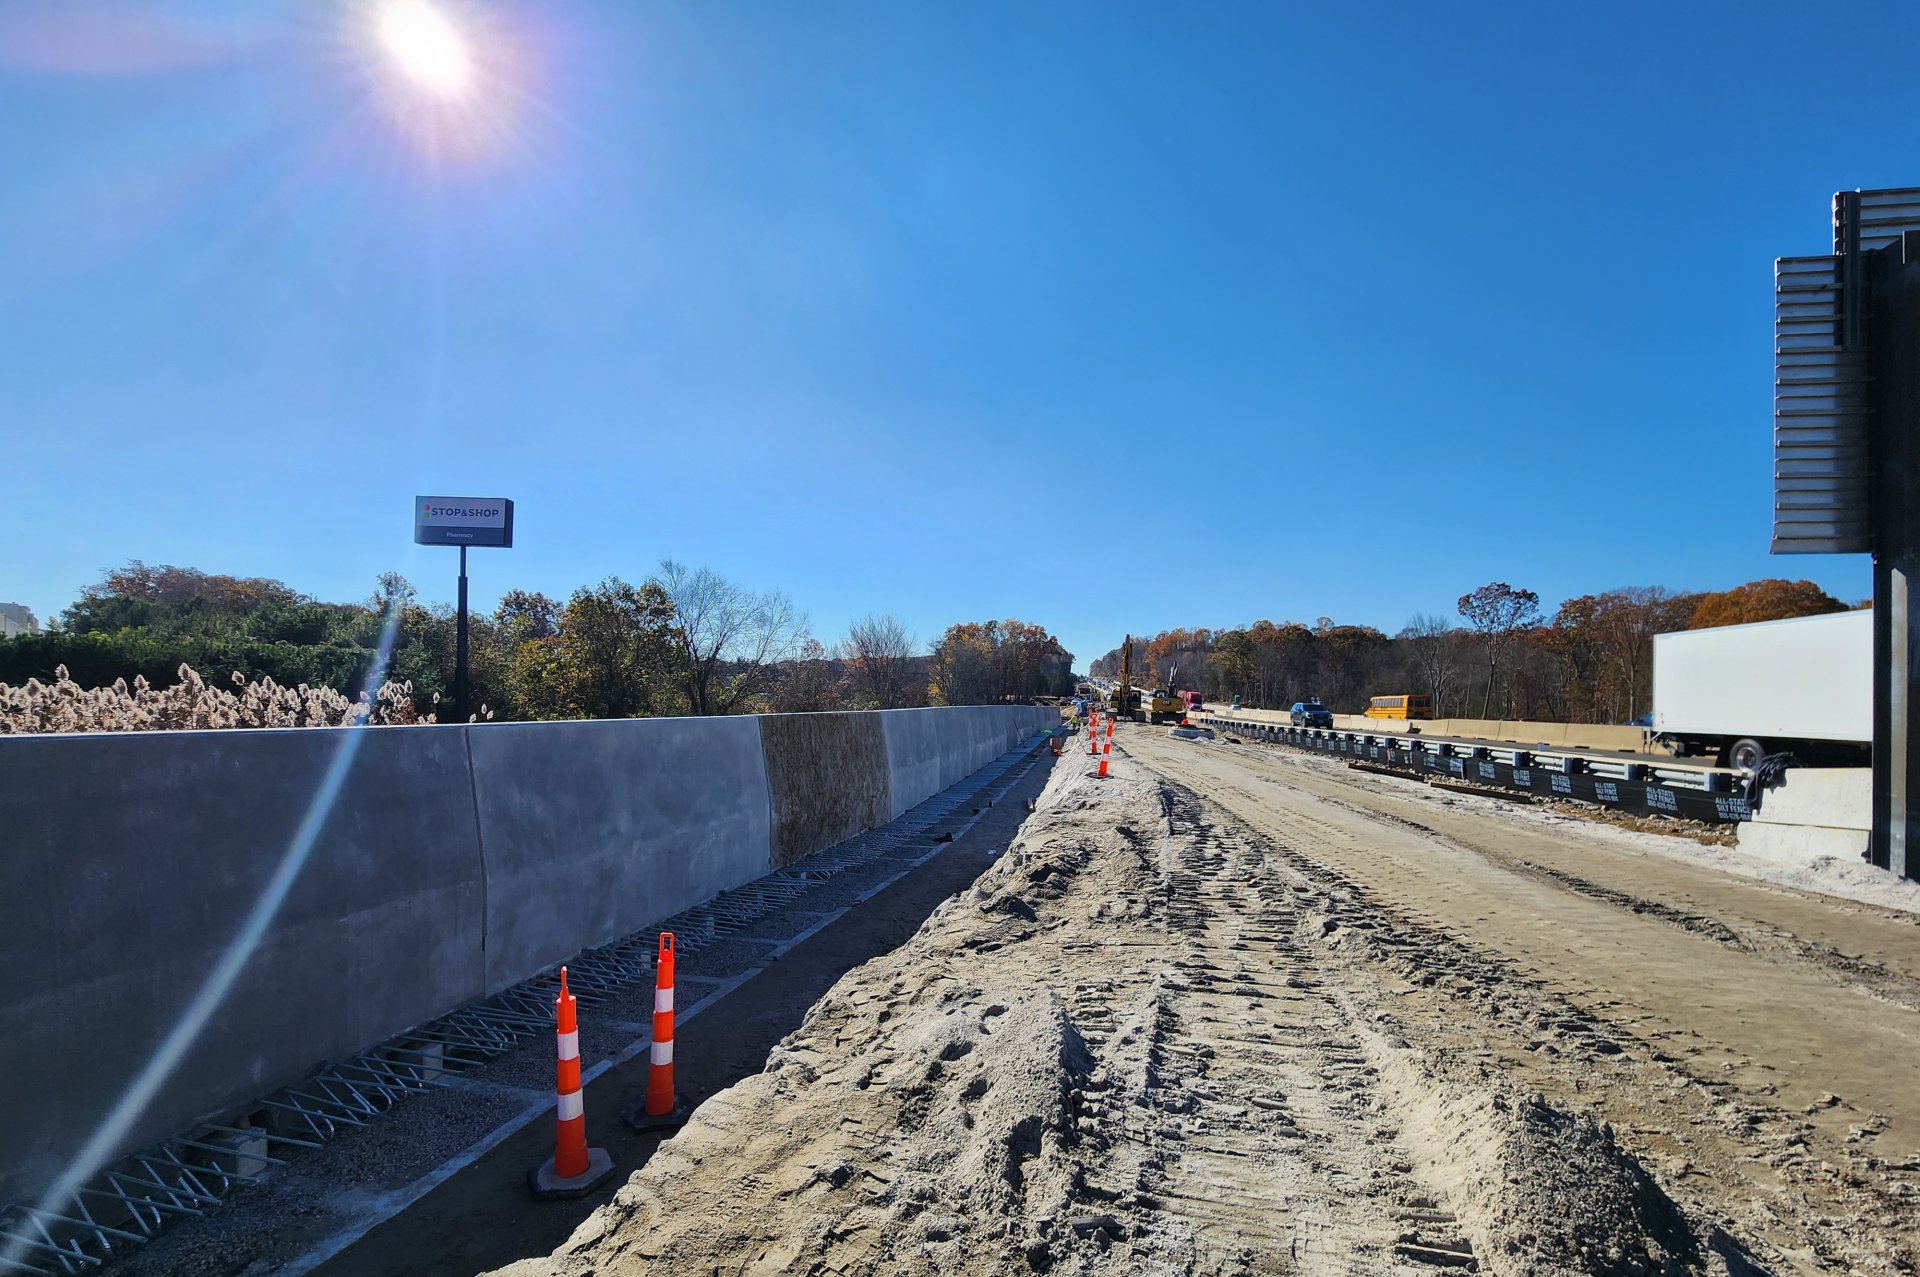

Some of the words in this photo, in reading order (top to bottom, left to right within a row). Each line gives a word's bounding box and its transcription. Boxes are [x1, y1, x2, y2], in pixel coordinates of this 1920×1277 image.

[431, 507, 499, 518] STOP&SHOP
[446, 531, 474, 540] Pharmacy
[1594, 782, 1617, 790] ALL-STATE
[1646, 786, 1675, 796] ALL-STATE
[1647, 793, 1658, 801] SILT
[1658, 795, 1676, 805] FENCE
[1715, 797, 1746, 806] ALL-STAT
[1716, 804, 1729, 812] SILT
